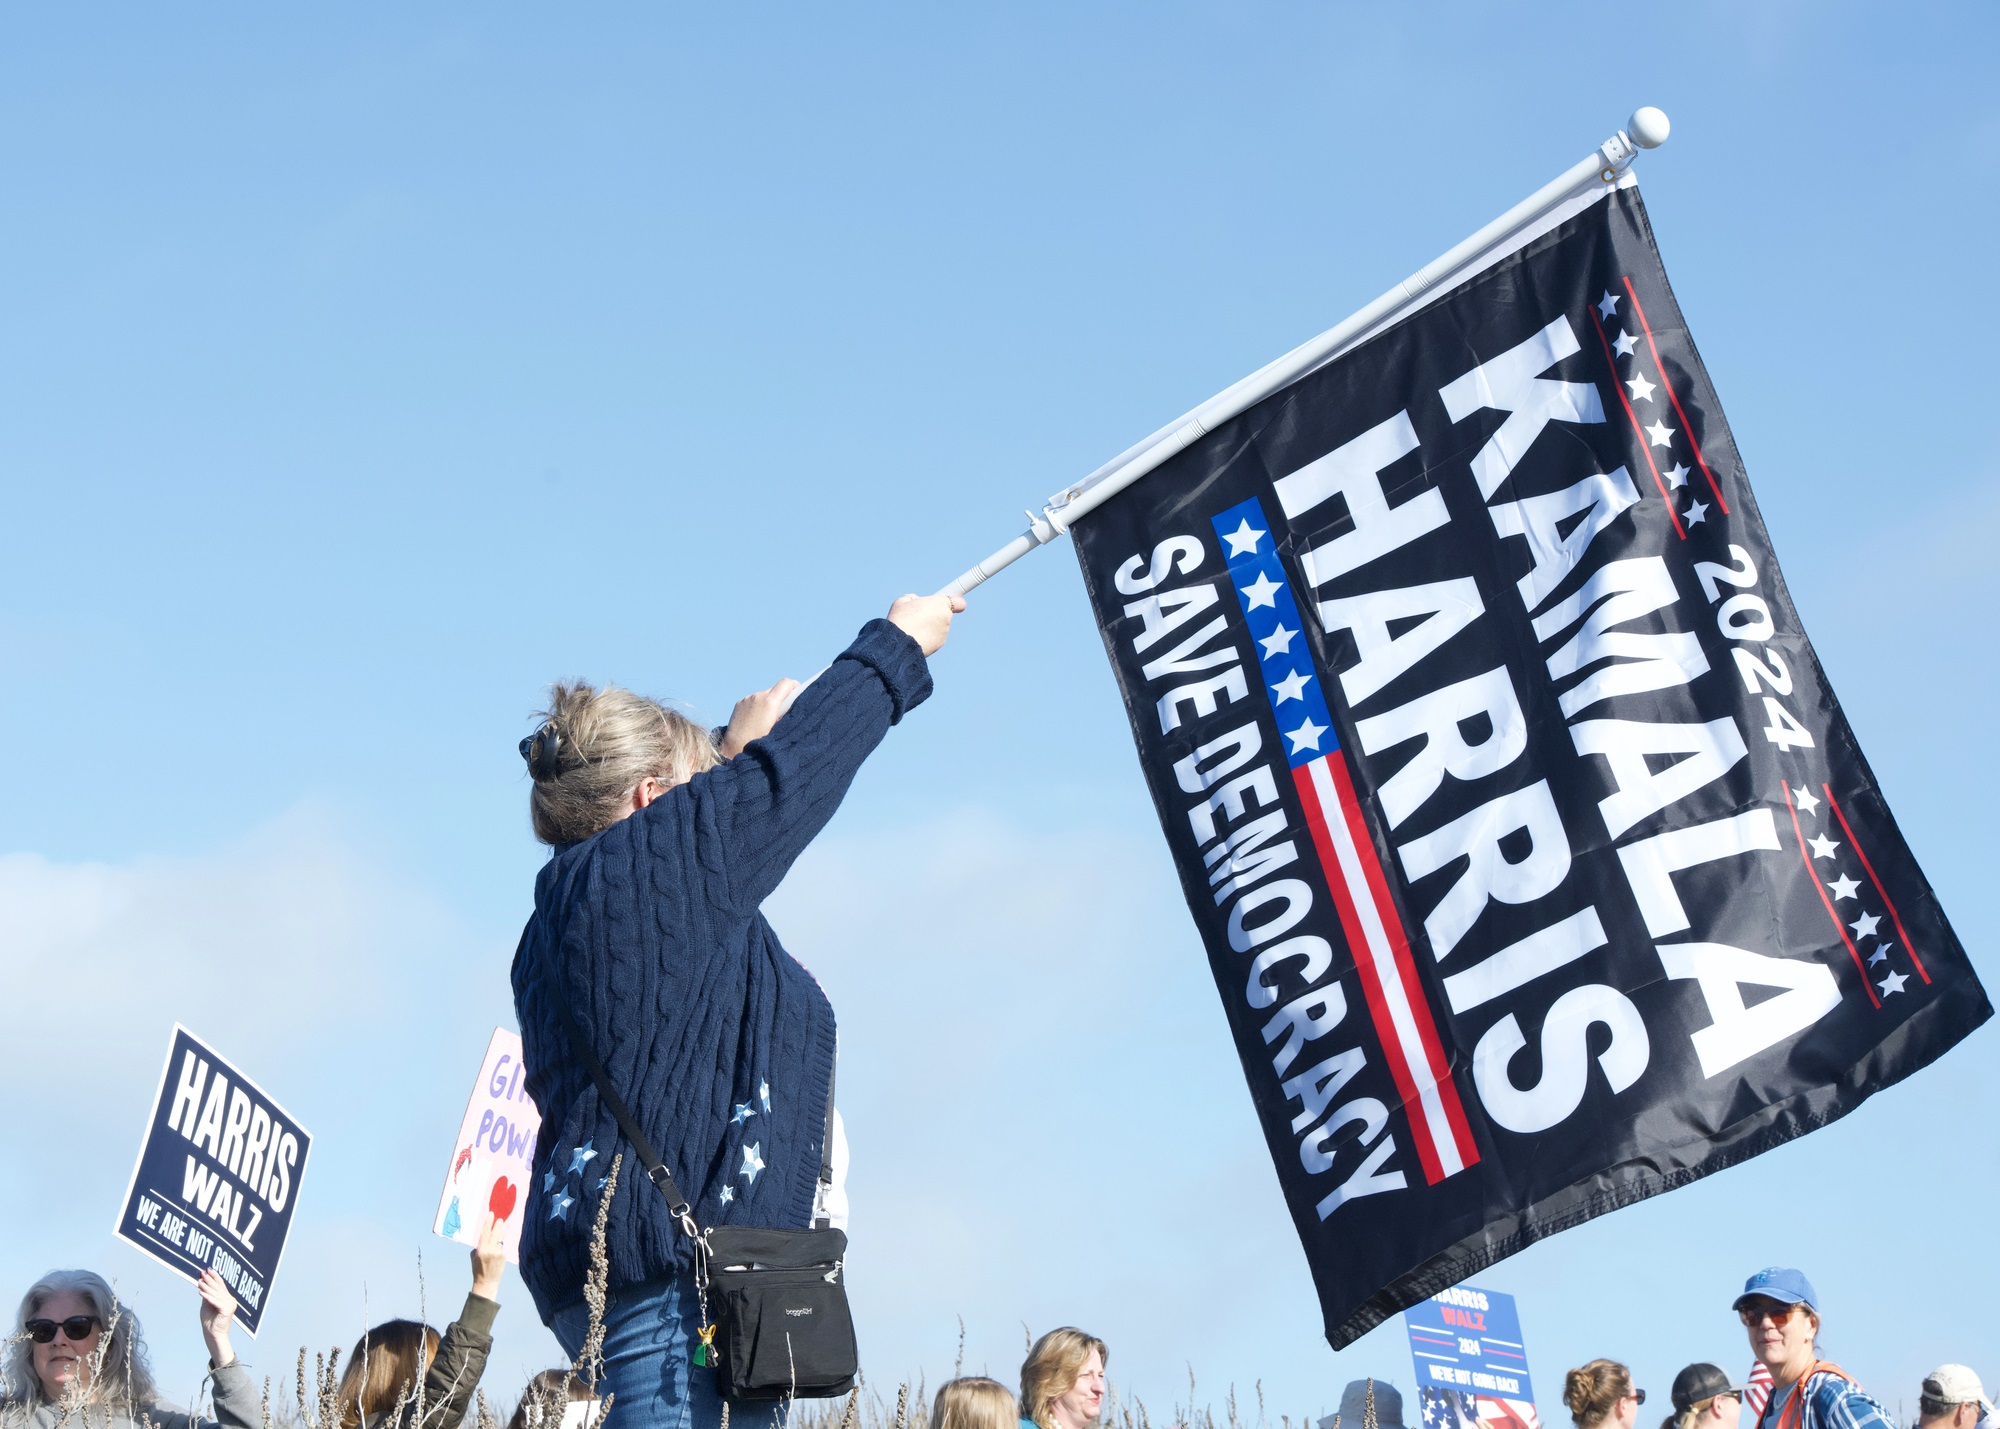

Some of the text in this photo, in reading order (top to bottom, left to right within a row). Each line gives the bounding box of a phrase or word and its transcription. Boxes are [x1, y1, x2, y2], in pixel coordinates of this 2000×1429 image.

[1438, 312, 1843, 1080] KAMALA
[1696, 543, 1817, 755] 2024
[1273, 409, 1651, 1134] HARRIS
[1113, 534, 1409, 1223] SAVE DEMOCRACY
[167, 1048, 299, 1213] HARRIS
[136, 1195, 264, 1311] WE ARE NOT GOING BACK
[182, 1154, 263, 1253] WALZ
[1428, 1364, 1520, 1394] WE'RE NOT GOING BACK!
[1440, 1306, 1487, 1331] WALZ
[1457, 1337, 1481, 1356] 2024
